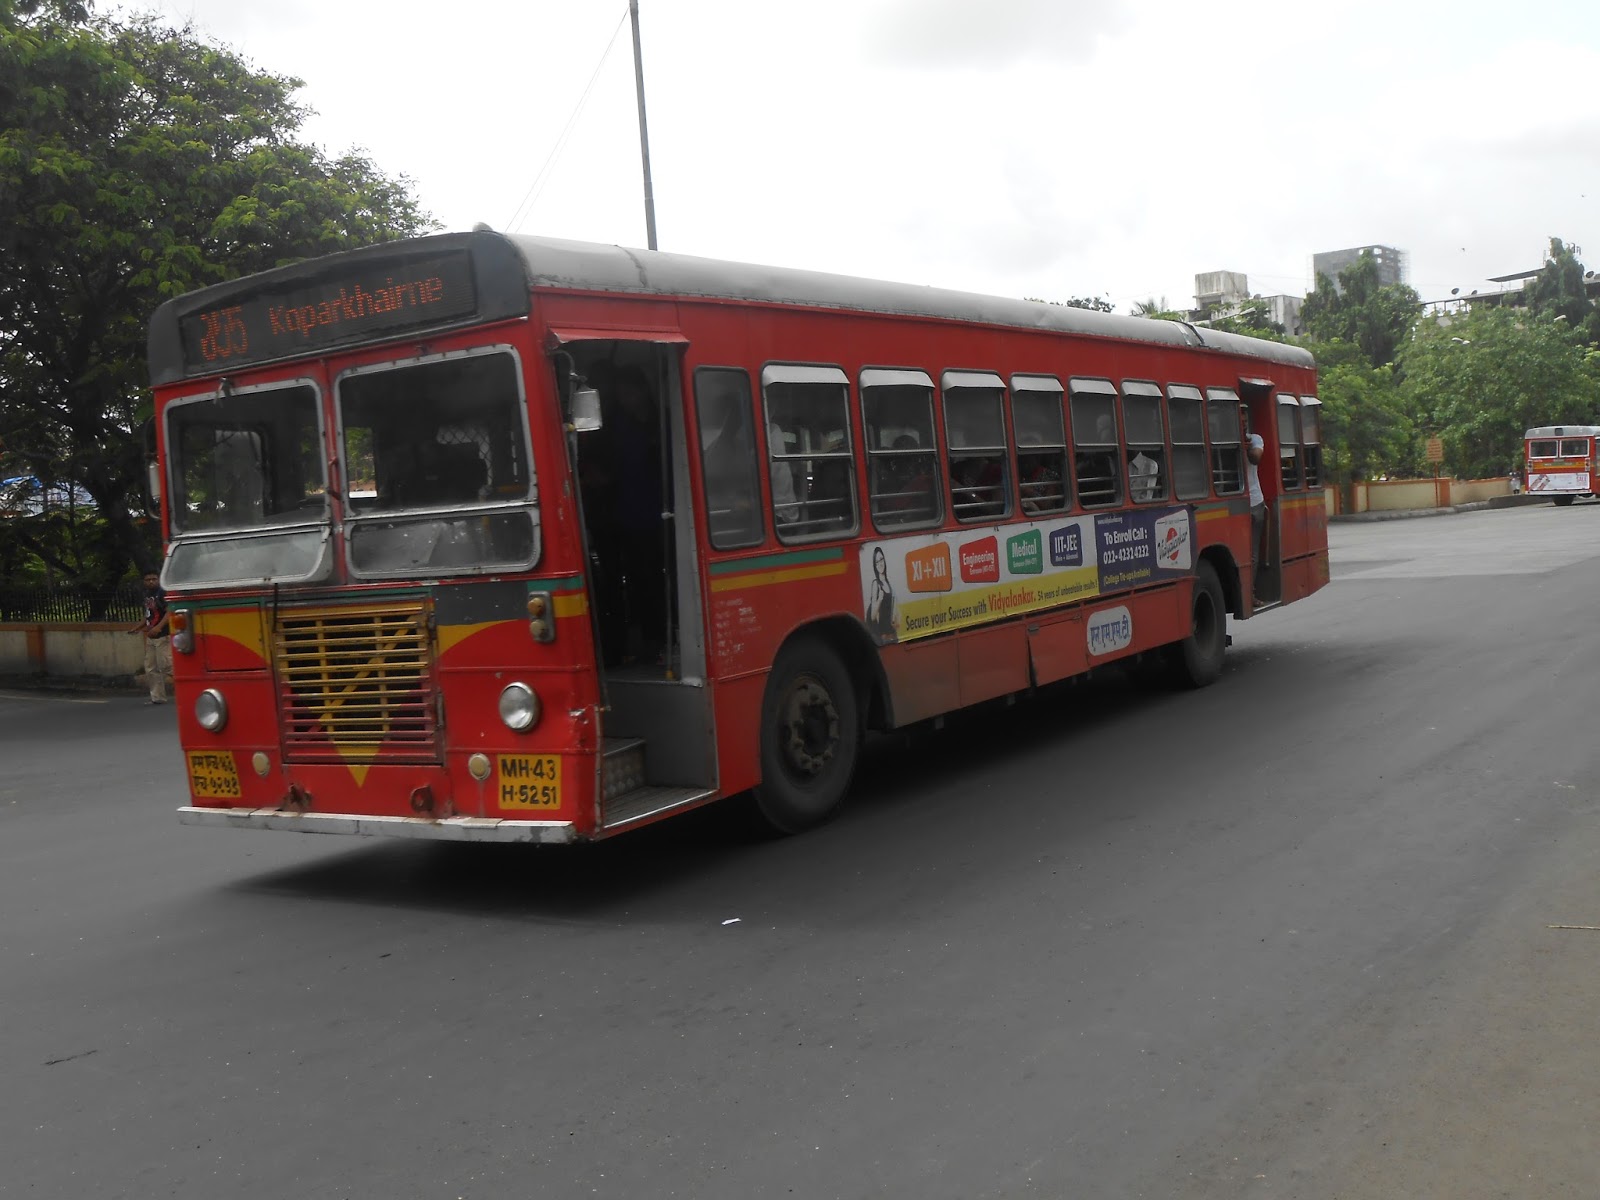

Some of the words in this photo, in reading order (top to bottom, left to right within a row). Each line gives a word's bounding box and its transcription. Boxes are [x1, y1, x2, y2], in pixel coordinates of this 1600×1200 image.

[1054, 533, 1078, 554] IIT-JEE
[1104, 531, 1113, 545] To
[1113, 528, 1132, 544] Enroll
[1011, 539, 1037, 558] Medical
[963, 550, 994, 568] Engineering
[905, 615, 930, 631] Secure
[931, 612, 947, 628] your
[948, 606, 973, 621] Success
[973, 599, 987, 616] with
[1044, 591, 1055, 602] years
[1055, 586, 1060, 598] of
[1060, 582, 1083, 597] unbeatable
